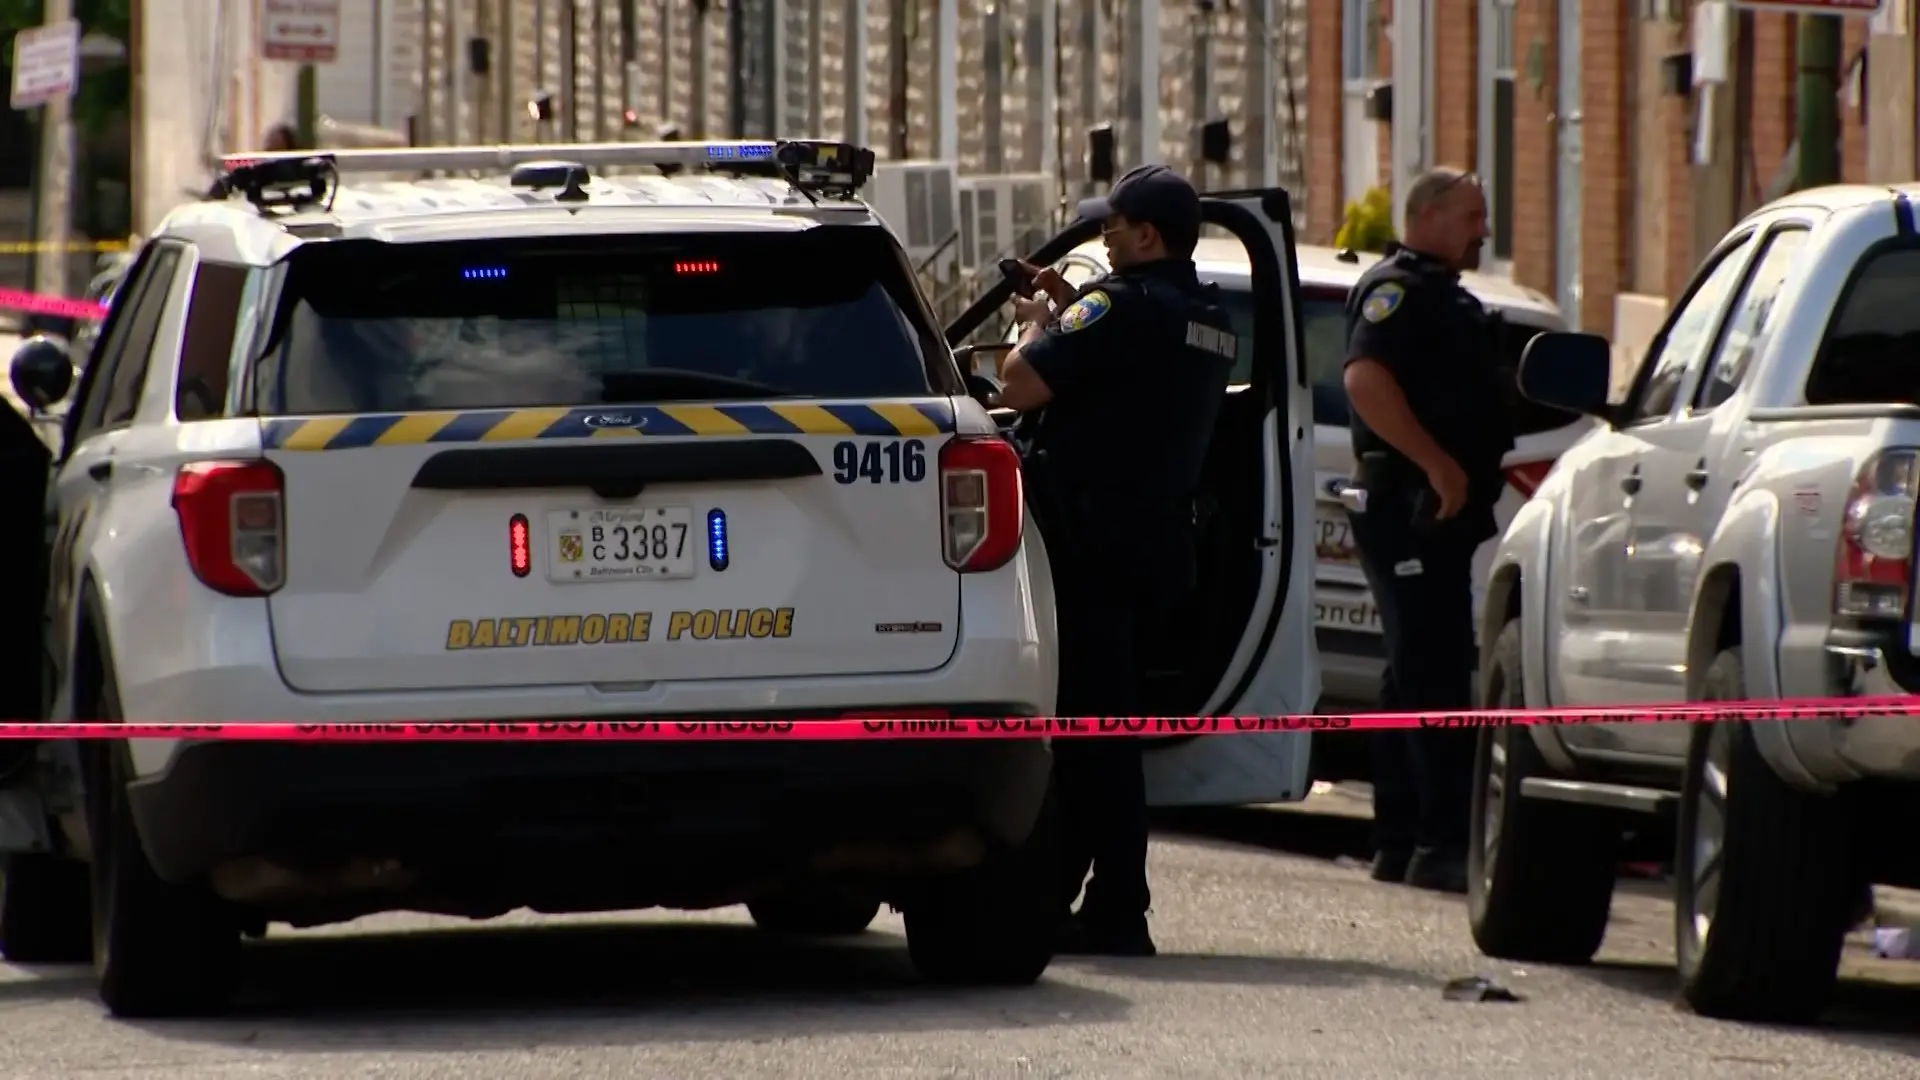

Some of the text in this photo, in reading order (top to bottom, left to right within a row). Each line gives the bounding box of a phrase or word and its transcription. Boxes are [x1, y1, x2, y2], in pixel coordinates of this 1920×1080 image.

[833, 439, 926, 484] 9416
[612, 523, 688, 561] 3387
[446, 607, 795, 650] BALTIMORE POLICE
